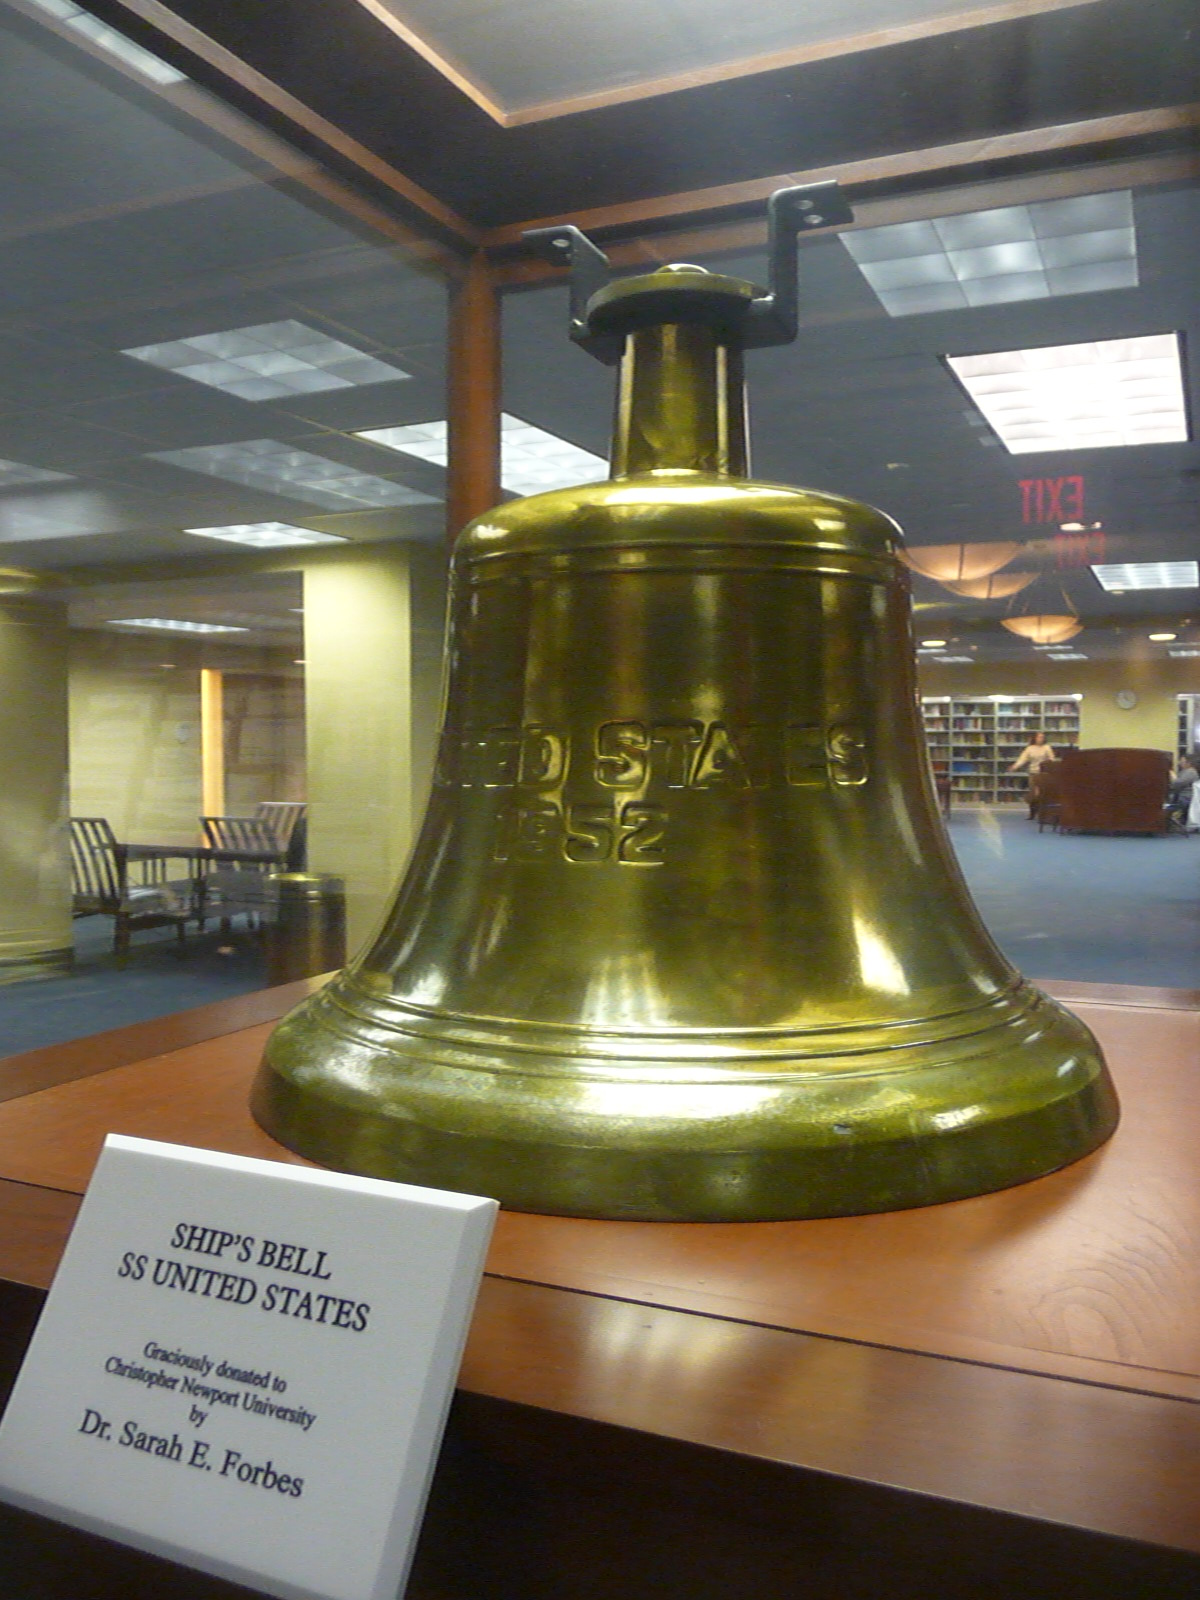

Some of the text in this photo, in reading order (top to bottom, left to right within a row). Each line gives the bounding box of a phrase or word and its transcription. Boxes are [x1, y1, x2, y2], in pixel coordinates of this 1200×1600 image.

[595, 719, 869, 789] STAES
[170, 1222, 332, 1281] SHIP'S BELL
[117, 1251, 371, 1333] SS UNITED STATES
[104, 1356, 317, 1432] Christopher Newport University
[143, 1341, 288, 1394] Graciously donated to
[188, 1403, 209, 1429] by
[78, 1408, 305, 1498] Dr. Sarah E. Forbes
